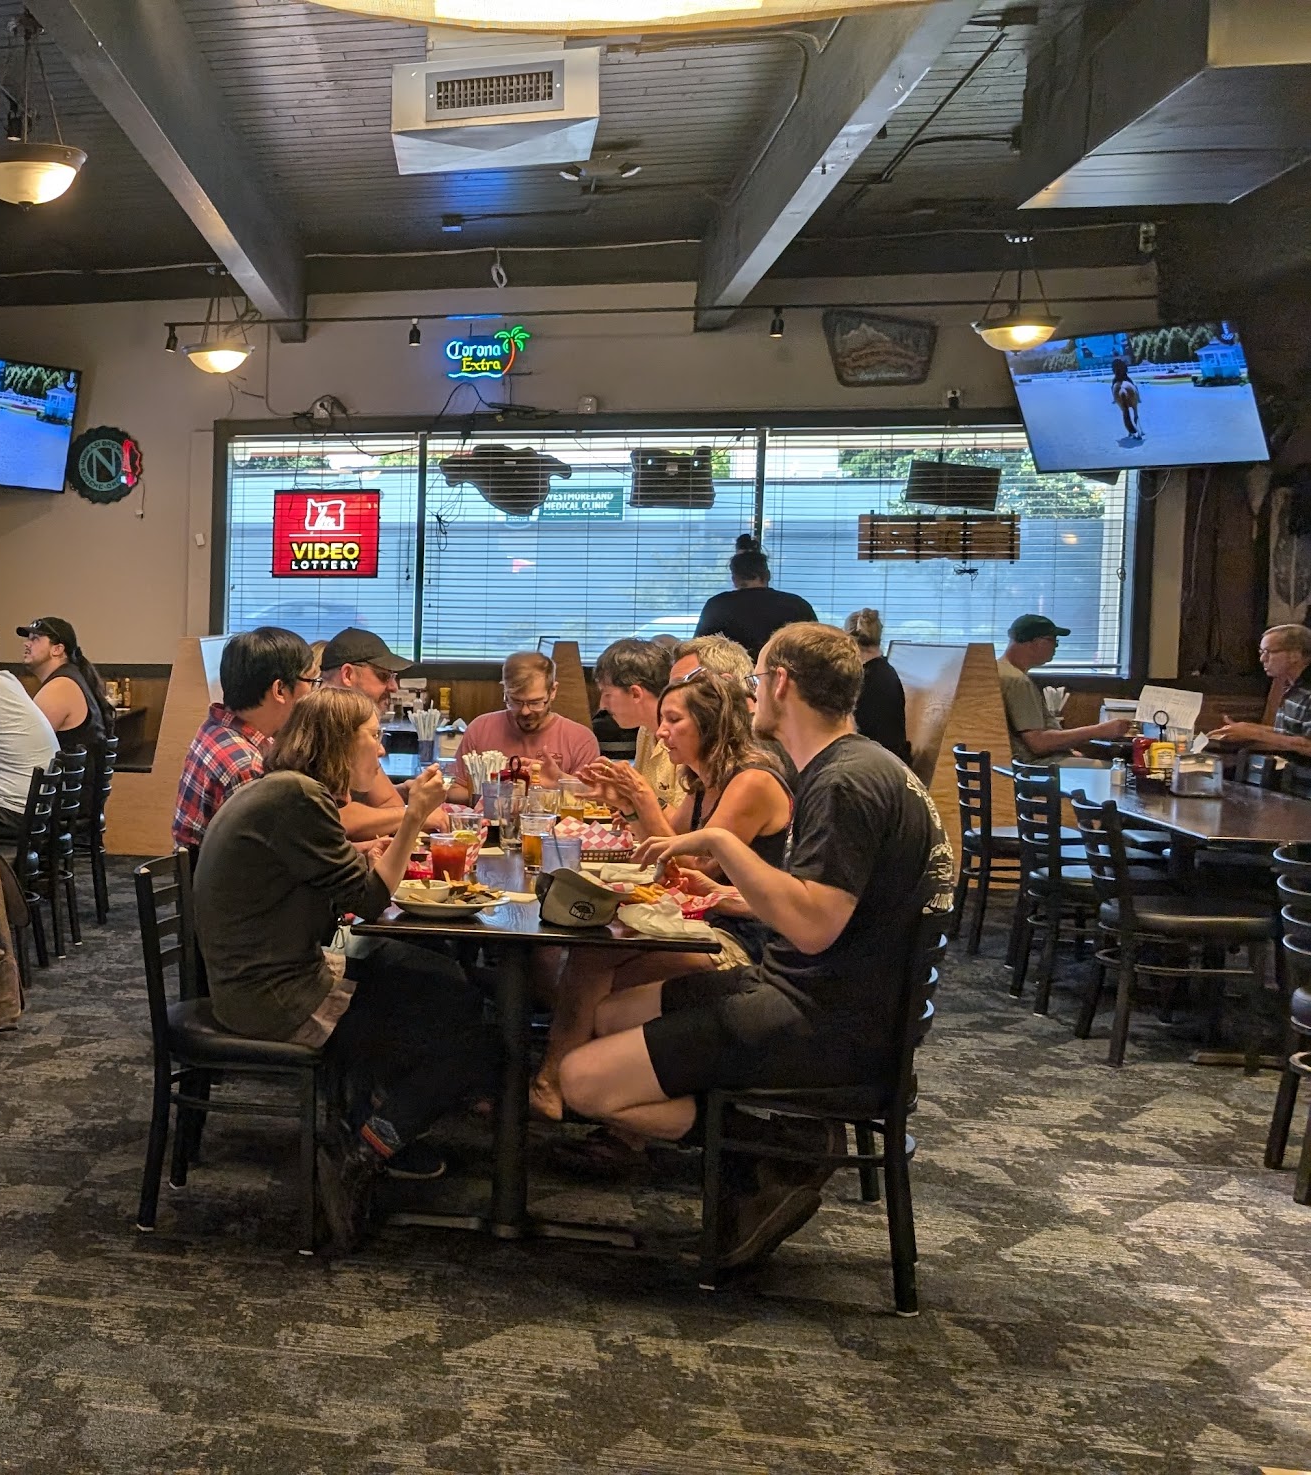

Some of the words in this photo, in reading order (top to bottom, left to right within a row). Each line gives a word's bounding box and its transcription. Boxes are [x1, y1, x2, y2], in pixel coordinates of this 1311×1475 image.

[446, 340, 502, 360] Corona
[461, 357, 502, 372] Extra
[92, 447, 116, 482] N
[80, 467, 103, 490] EUGENE
[543, 501, 580, 511] MEDICAL
[581, 501, 610, 511] CLINIC
[291, 541, 360, 560] VIDEO
[291, 560, 359, 570] LOTTERY
